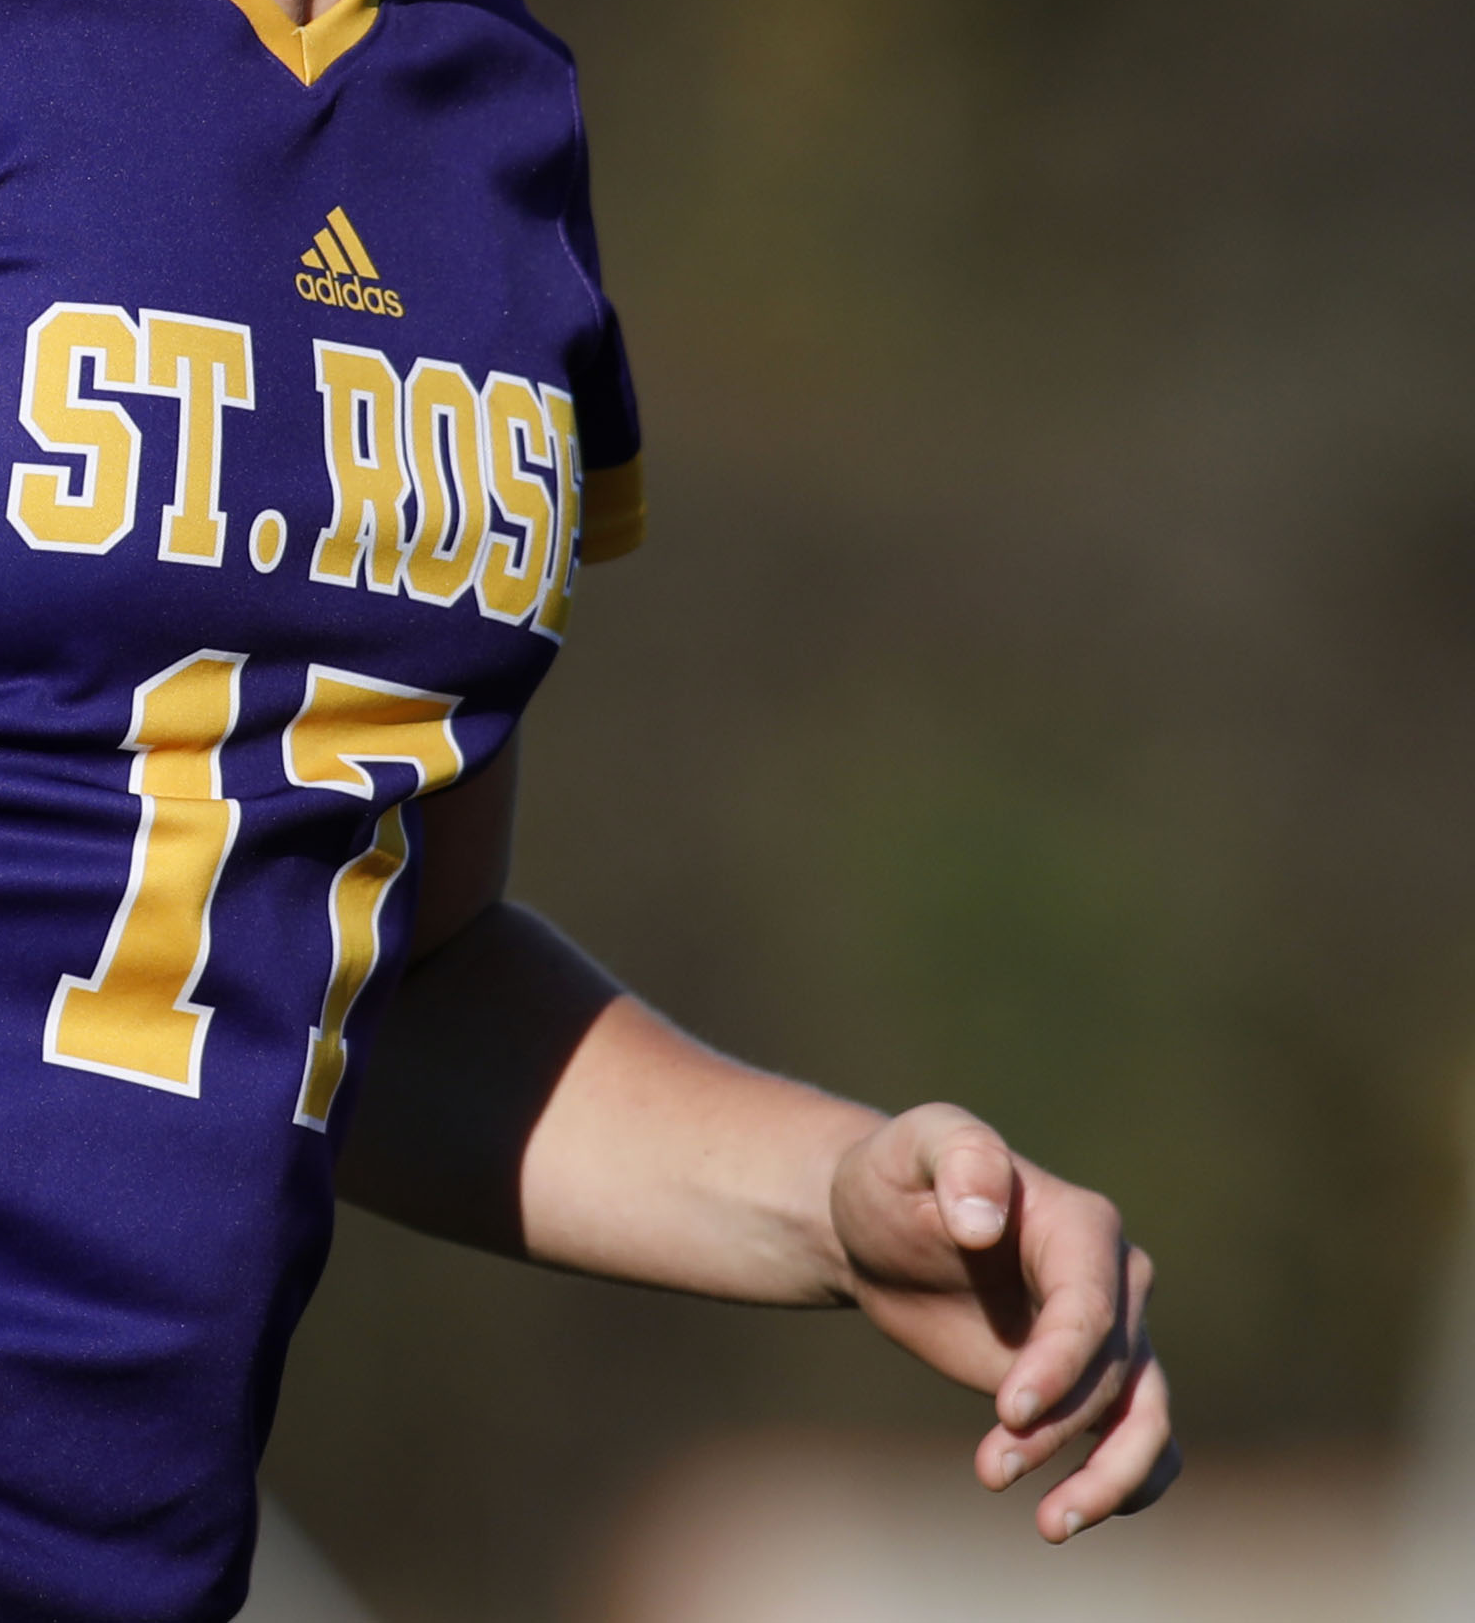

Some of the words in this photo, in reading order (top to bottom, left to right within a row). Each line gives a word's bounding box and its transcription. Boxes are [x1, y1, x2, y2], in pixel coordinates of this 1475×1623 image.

[295, 269, 405, 318] adidas
[6, 302, 288, 574] ST.
[42, 648, 465, 1134] 17
